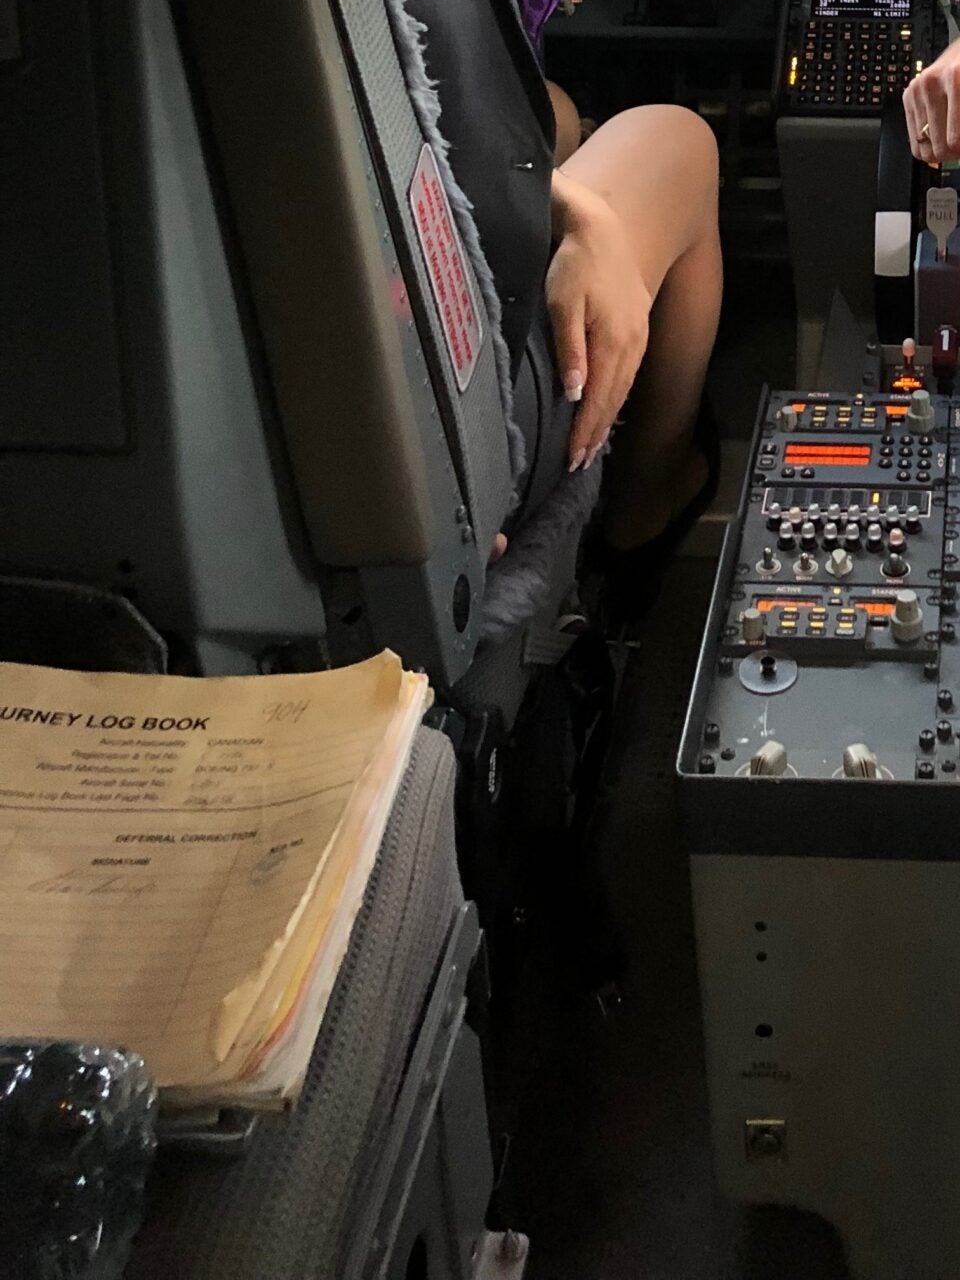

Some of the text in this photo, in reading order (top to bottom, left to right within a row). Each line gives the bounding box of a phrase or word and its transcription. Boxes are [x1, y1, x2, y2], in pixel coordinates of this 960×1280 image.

[940, 329, 951, 351] 1
[86, 715, 136, 730] LOG
[142, 717, 211, 731] BOOK
[115, 831, 259, 843] DEFERRAL CORRECTION
